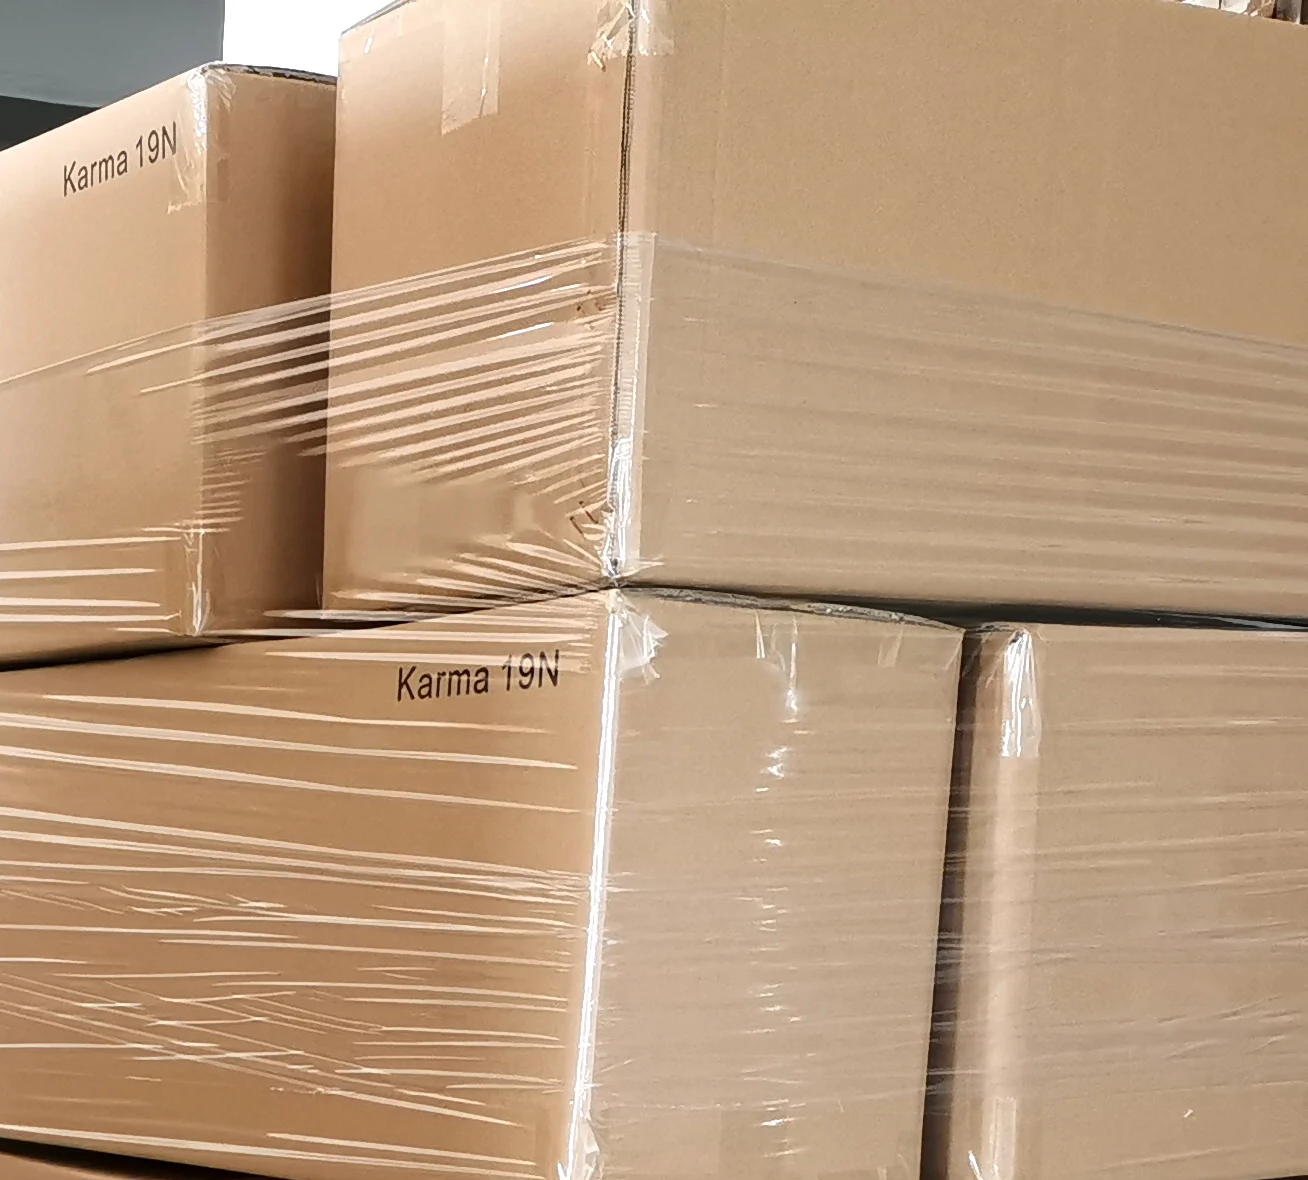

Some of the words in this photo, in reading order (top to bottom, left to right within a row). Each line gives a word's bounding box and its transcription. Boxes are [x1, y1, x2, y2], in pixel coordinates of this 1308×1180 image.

[63, 150, 128, 198] Karma
[135, 120, 177, 168] 19N
[397, 665, 490, 702] Karma
[501, 648, 560, 691] 19N
